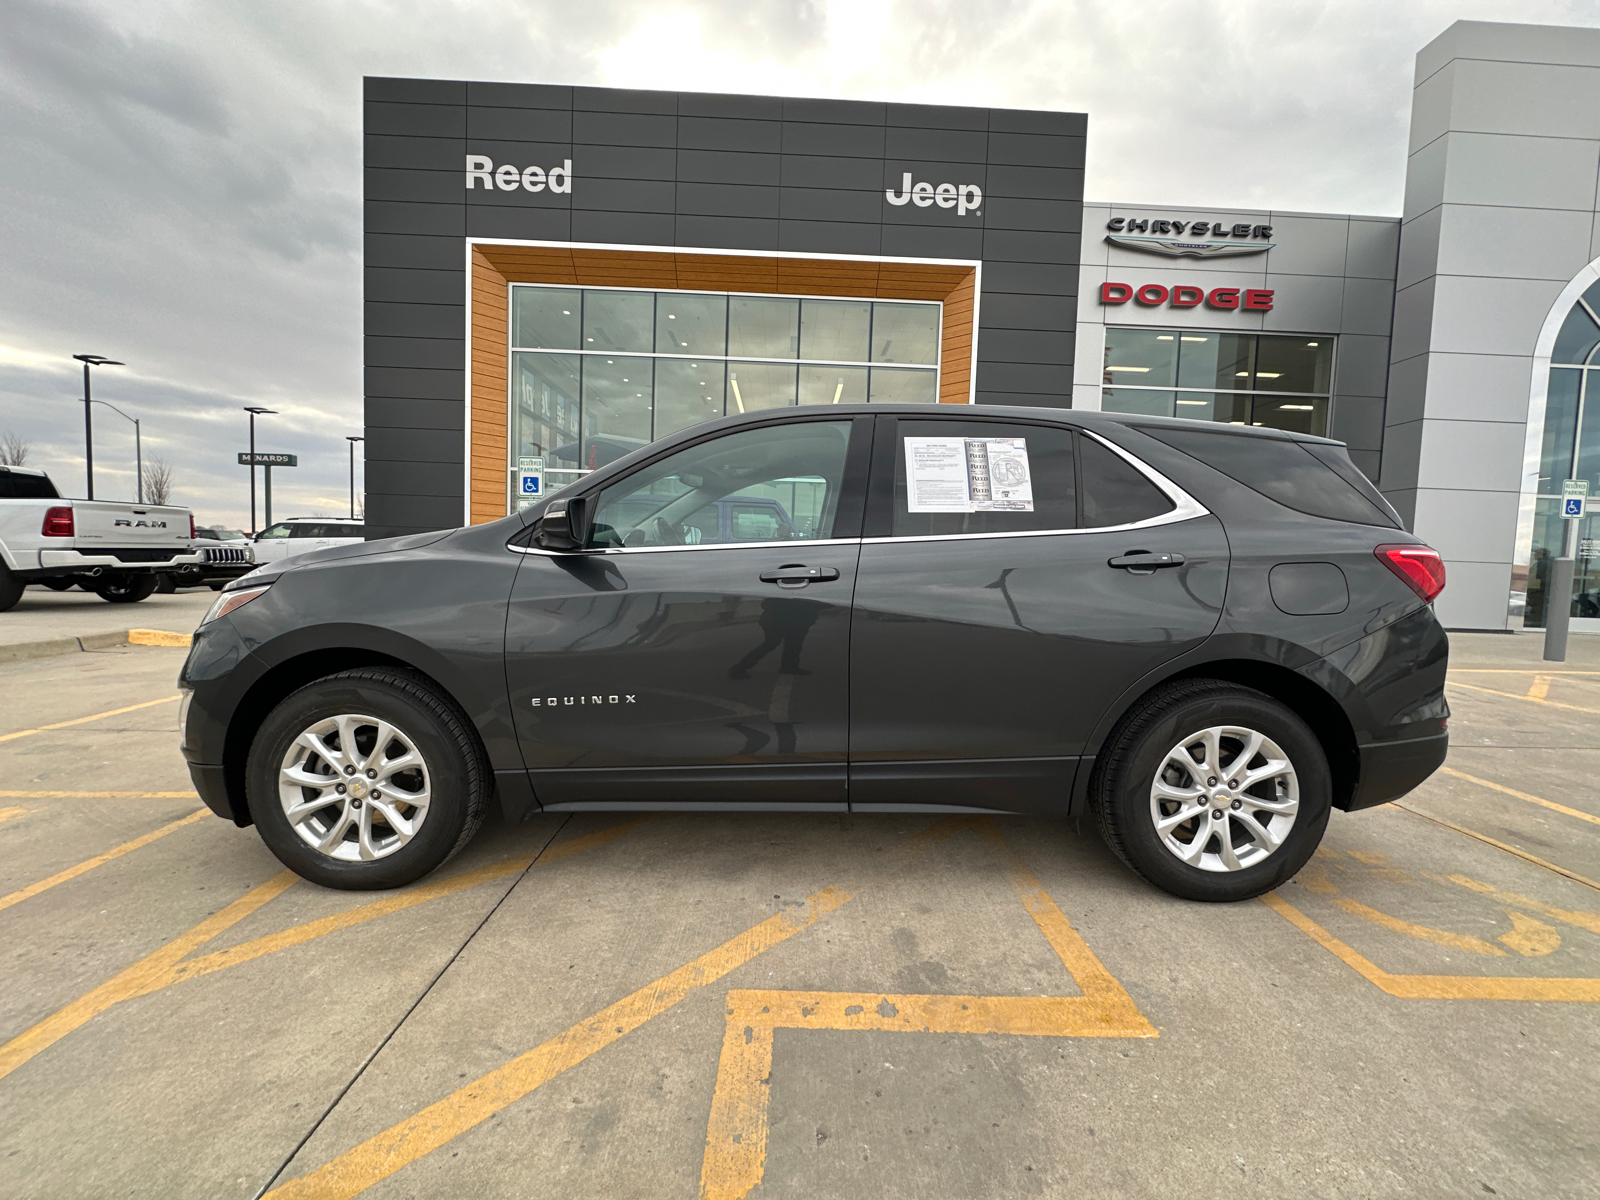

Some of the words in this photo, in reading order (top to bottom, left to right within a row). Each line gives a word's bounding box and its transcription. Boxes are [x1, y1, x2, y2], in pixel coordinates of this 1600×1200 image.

[466, 154, 573, 194] Reed
[885, 172, 983, 216] Jeep
[1107, 217, 1273, 238] CHRYSLER
[1099, 281, 1275, 312] DODGE
[114, 519, 167, 529] RAM
[531, 694, 636, 706] EQUINOX
